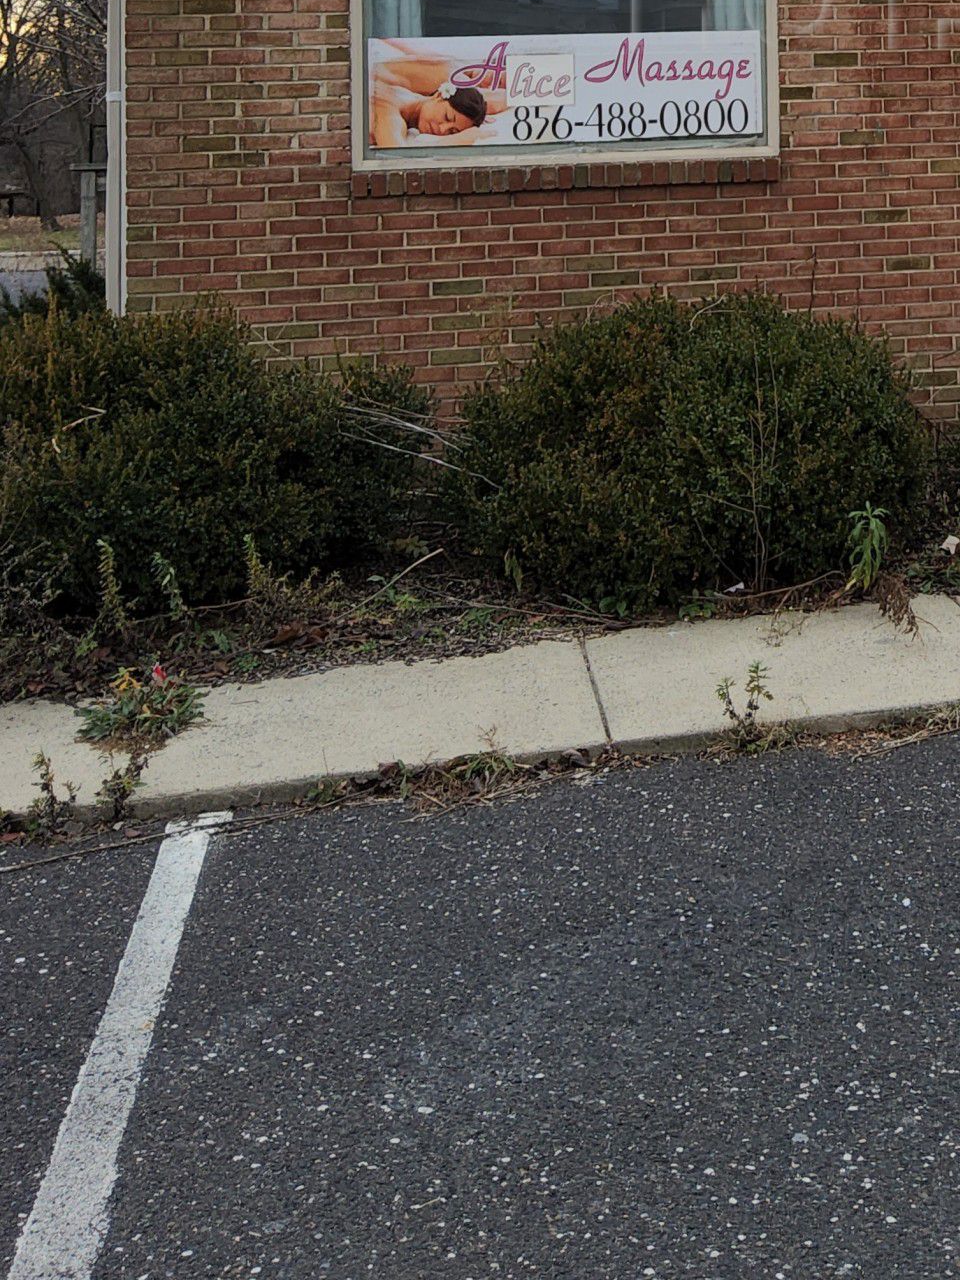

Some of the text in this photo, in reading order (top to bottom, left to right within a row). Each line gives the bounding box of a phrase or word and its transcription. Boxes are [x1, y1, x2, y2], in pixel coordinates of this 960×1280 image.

[450, 37, 752, 100] Alice Massage
[512, 97, 749, 141] 856-488-0800
